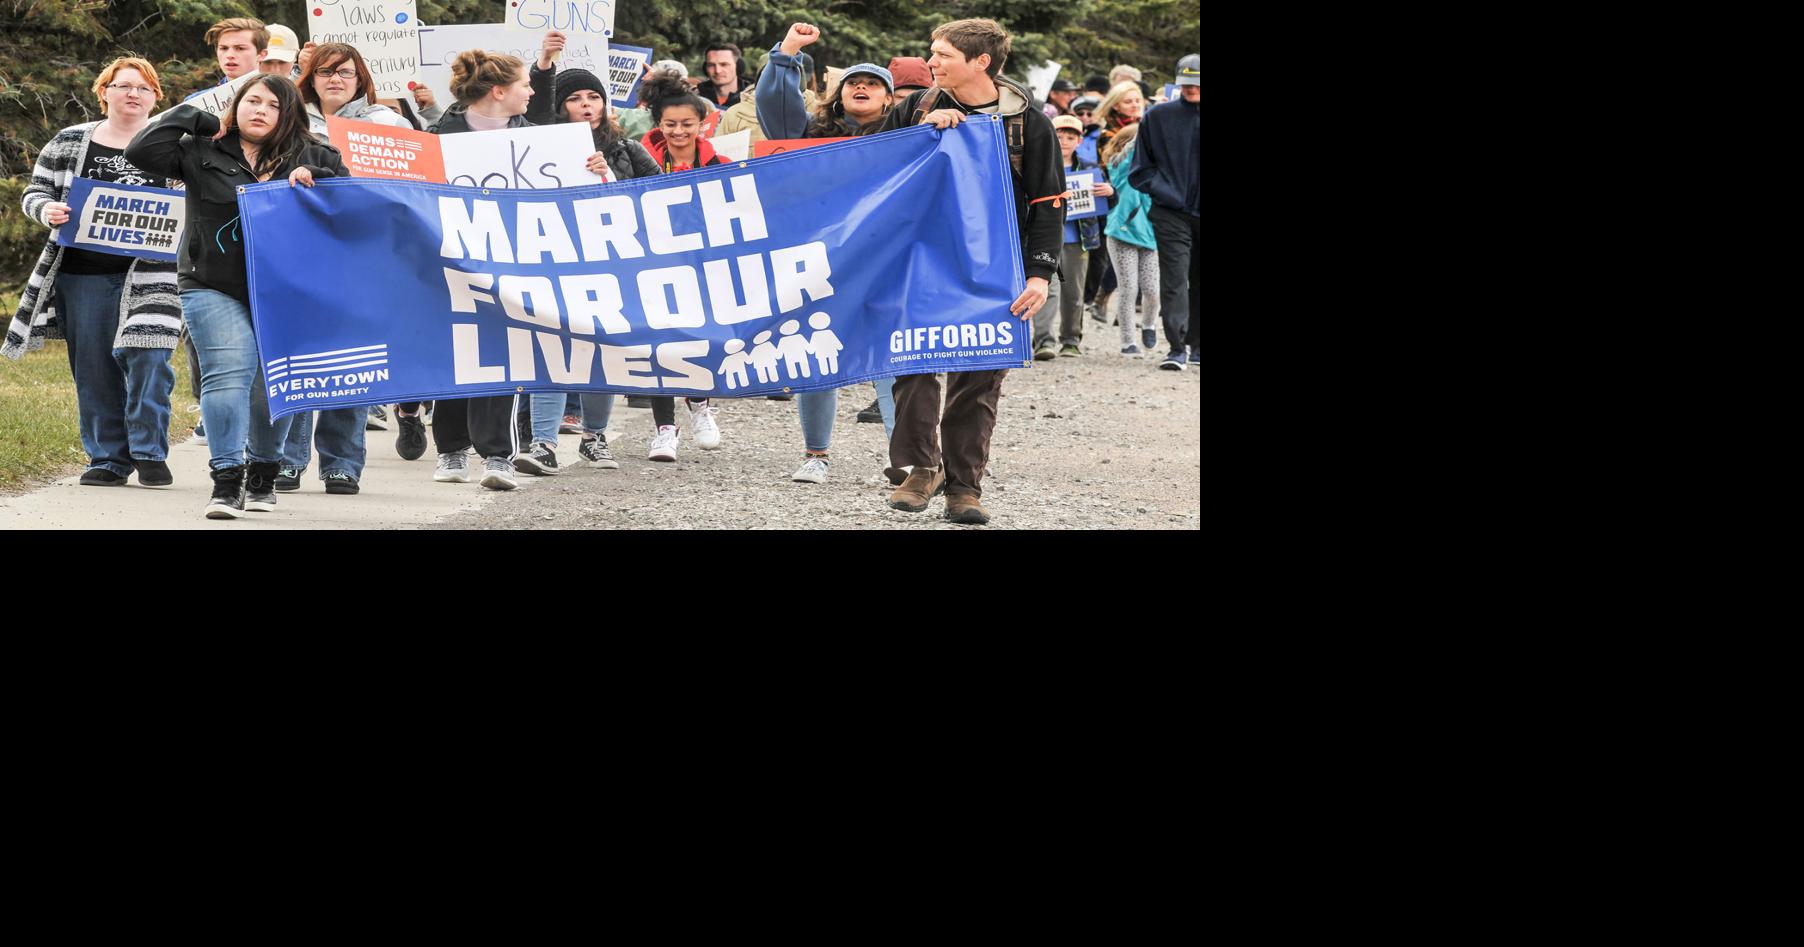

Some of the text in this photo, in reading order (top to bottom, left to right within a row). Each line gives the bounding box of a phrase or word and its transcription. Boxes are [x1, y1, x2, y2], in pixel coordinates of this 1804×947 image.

[341, 4, 386, 28] laws
[516, 0, 609, 34] GUNS
[365, 29, 416, 48] regulate
[347, 131, 395, 147] MOMS
[349, 142, 416, 160] DEMAND
[352, 154, 409, 170] ACTION
[95, 194, 170, 216] MARCH
[91, 209, 178, 233] FOR OUR
[438, 173, 769, 264] MARCH
[87, 225, 146, 245] LIVES
[443, 241, 835, 335] FOR OUR
[890, 321, 1014, 353] GIFFORDS
[452, 323, 715, 391] LIVES
[890, 353, 921, 363] COURAGE
[922, 352, 932, 360] TO
[934, 351, 956, 359] FIGHT
[975, 347, 1014, 356] VIOLENCE
[269, 368, 389, 398] EVERYTOWN
[285, 387, 369, 402] FOR GUN SAFETY
